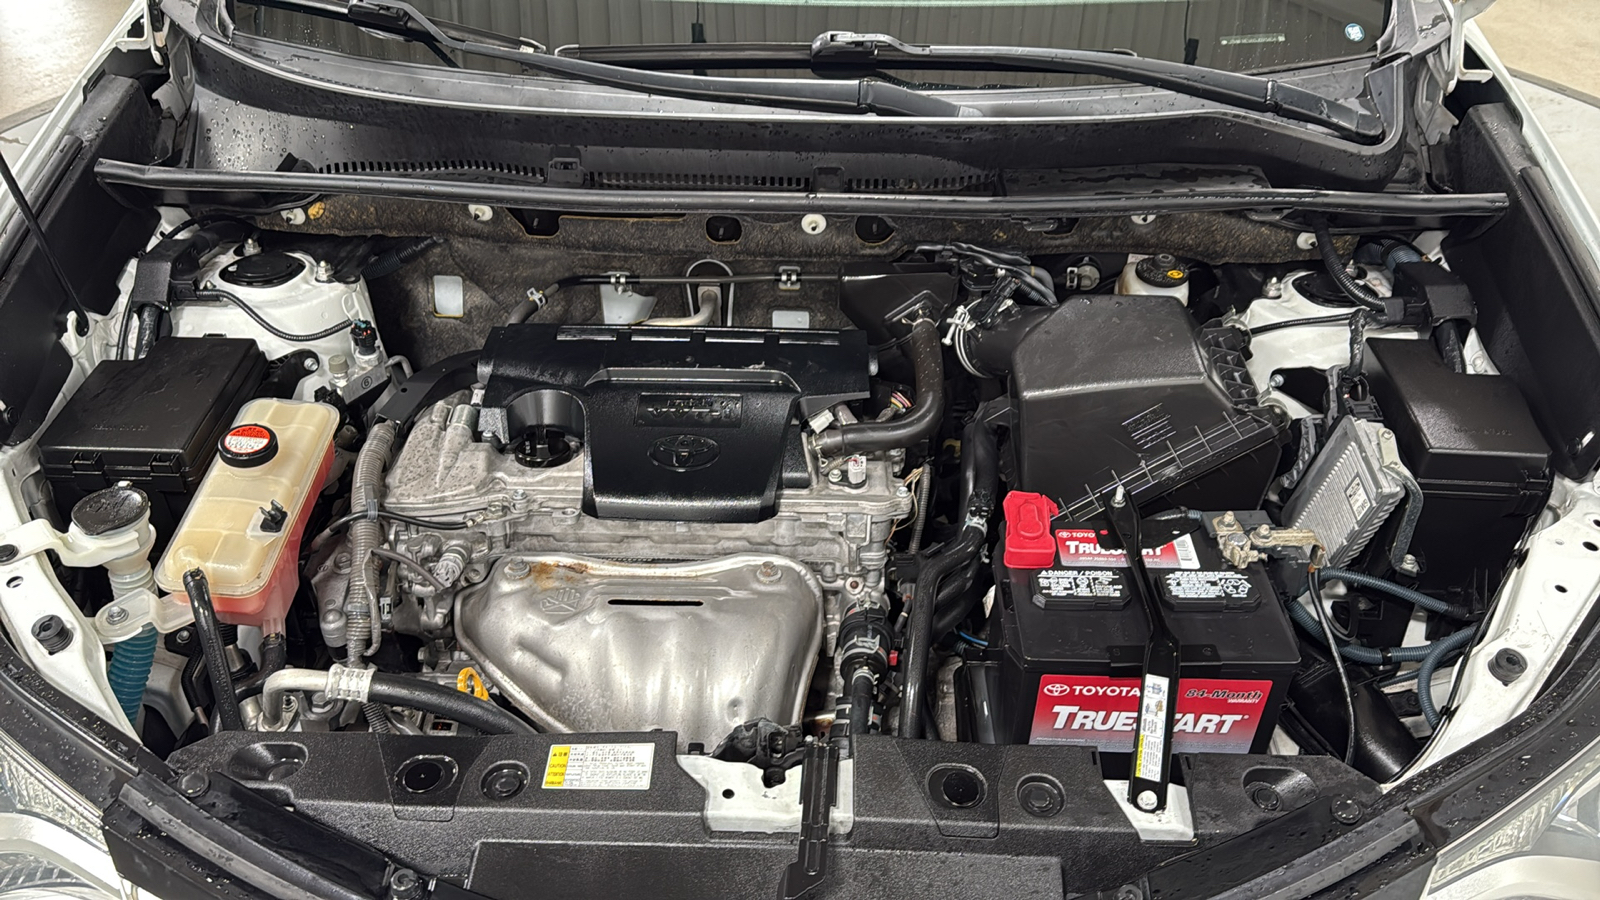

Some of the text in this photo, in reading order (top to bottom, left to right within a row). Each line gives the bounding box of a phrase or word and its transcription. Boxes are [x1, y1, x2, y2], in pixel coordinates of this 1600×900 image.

[1072, 685, 1140, 697] TOYOTA
[1185, 689, 1263, 700] 84-Month
[1052, 705, 1243, 734] TRUEART
